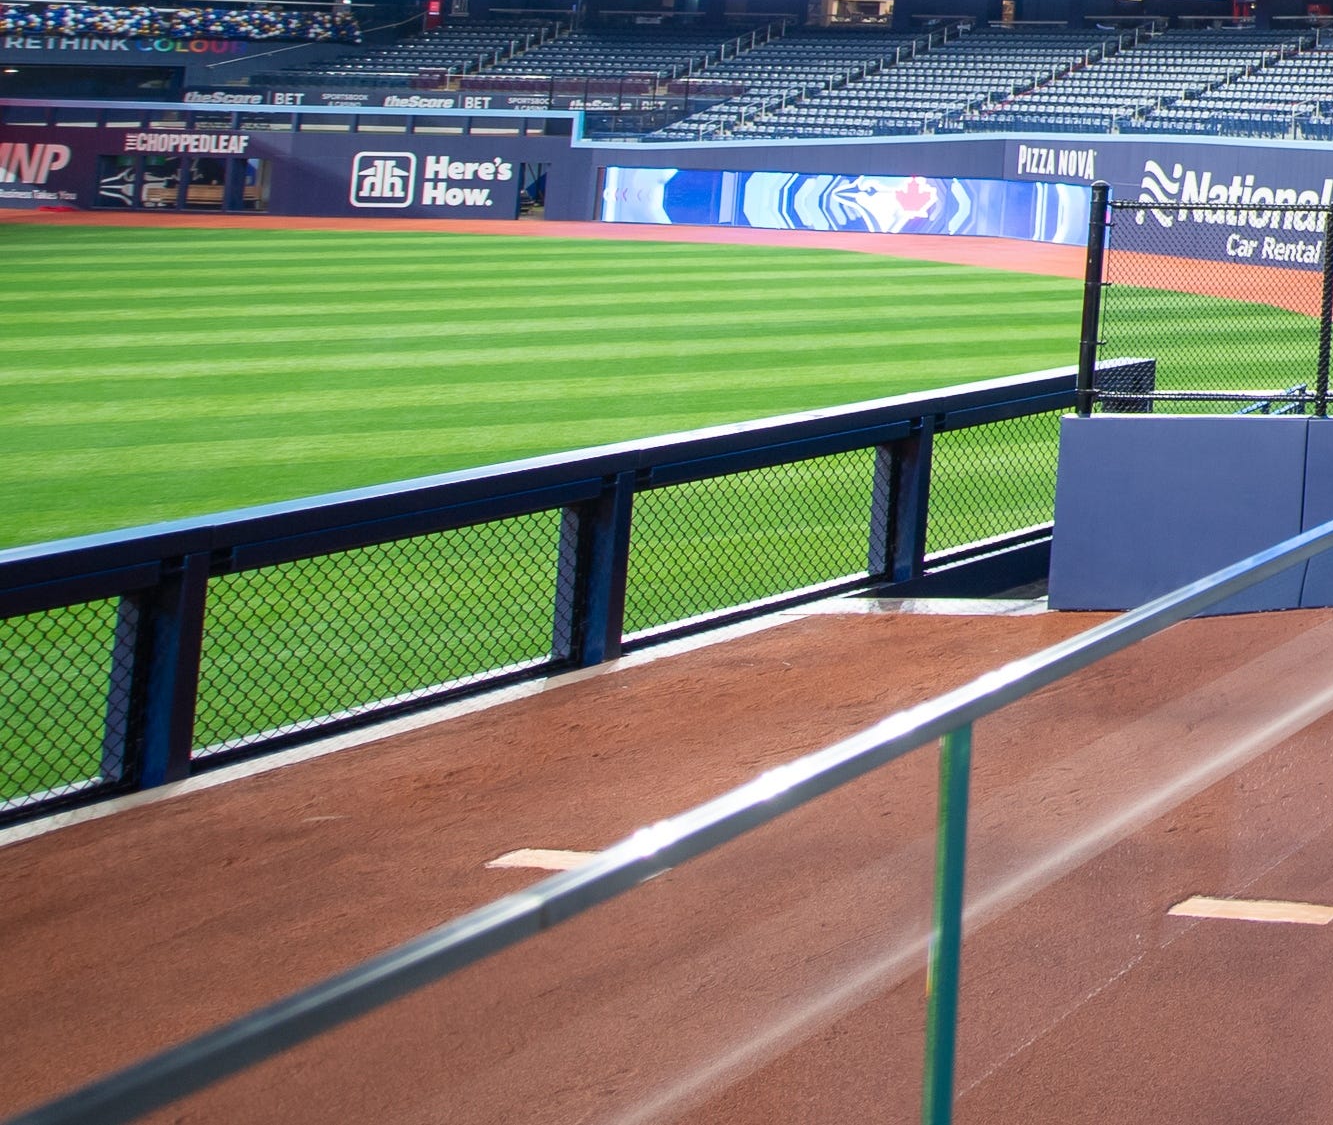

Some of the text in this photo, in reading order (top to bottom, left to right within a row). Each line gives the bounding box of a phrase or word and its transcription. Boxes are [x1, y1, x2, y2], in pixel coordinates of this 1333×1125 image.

[4, 36, 248, 54] RETHINK COLOUR
[183, 90, 304, 106] theScore BET
[321, 93, 369, 102] SPORTSBOOK
[384, 94, 492, 110] theScore BET
[124, 133, 138, 151] THE
[0, 142, 72, 185] NP
[1018, 145, 1095, 180] PIZZA NOVA
[33, 189, 58, 200] Takes
[58, 190, 78, 200] You
[425, 182, 493, 207] How.
[1226, 234, 1323, 264] Car Rental
